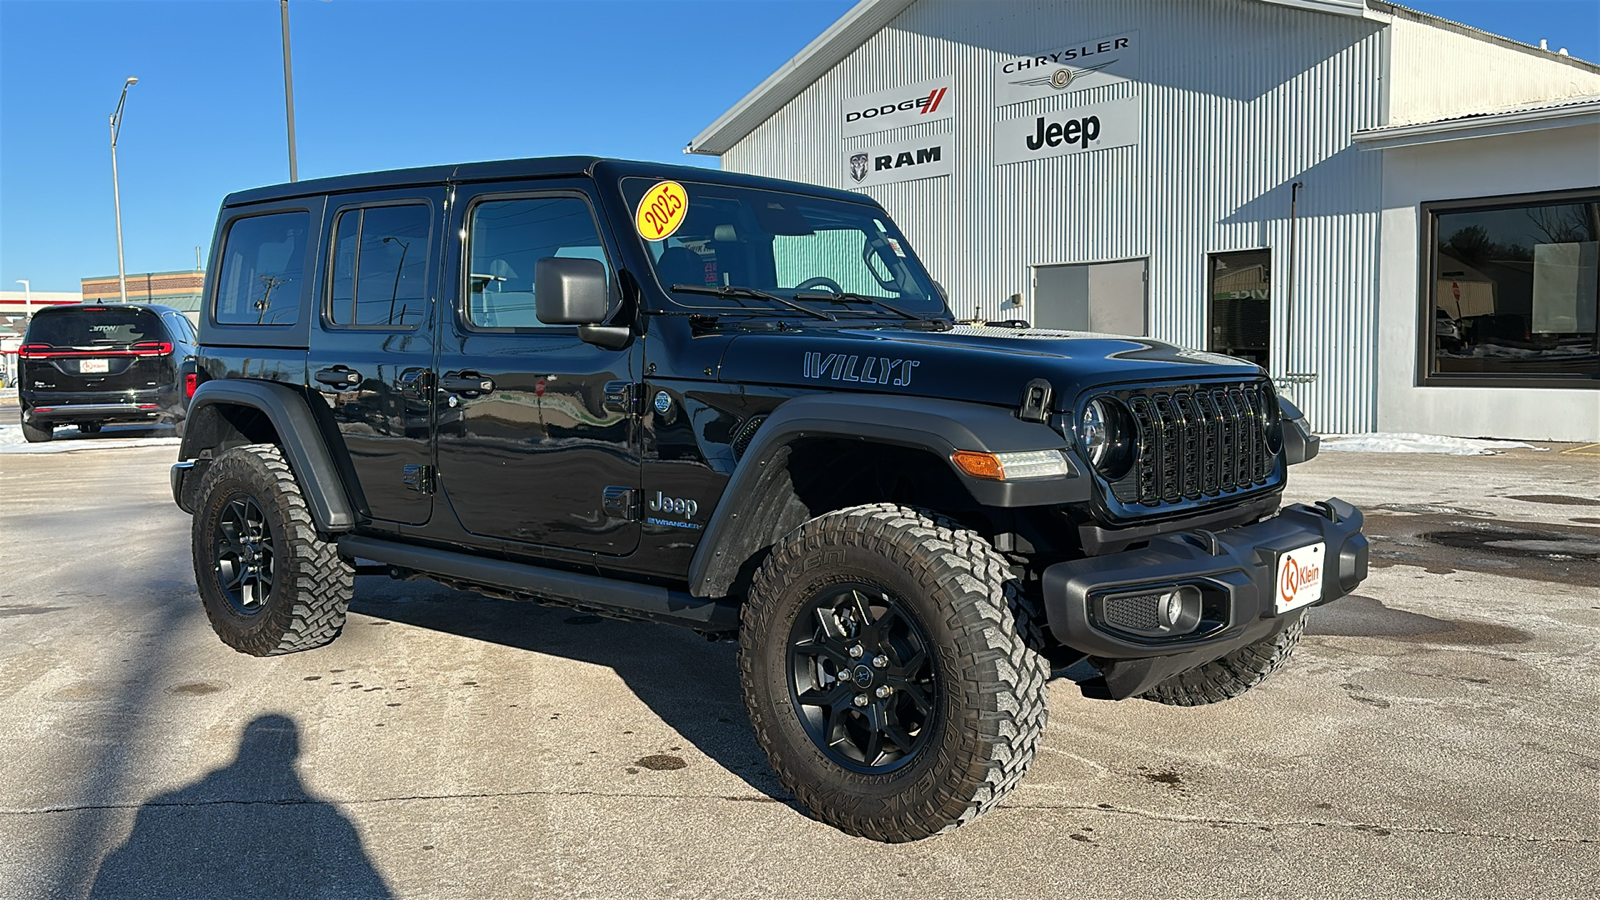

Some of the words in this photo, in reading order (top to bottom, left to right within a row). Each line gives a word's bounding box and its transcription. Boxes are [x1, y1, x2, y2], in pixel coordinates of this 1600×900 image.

[1002, 37, 1129, 74] CHRYSLER
[846, 96, 931, 123] DODGE
[1026, 115, 1101, 151] Jeep
[874, 146, 942, 171] RAM
[645, 186, 682, 235] 2025
[803, 351, 920, 387] WILLYS
[649, 490, 698, 520] Jeep
[655, 518, 701, 530] WRANGLER
[1299, 563, 1320, 586] Klein
